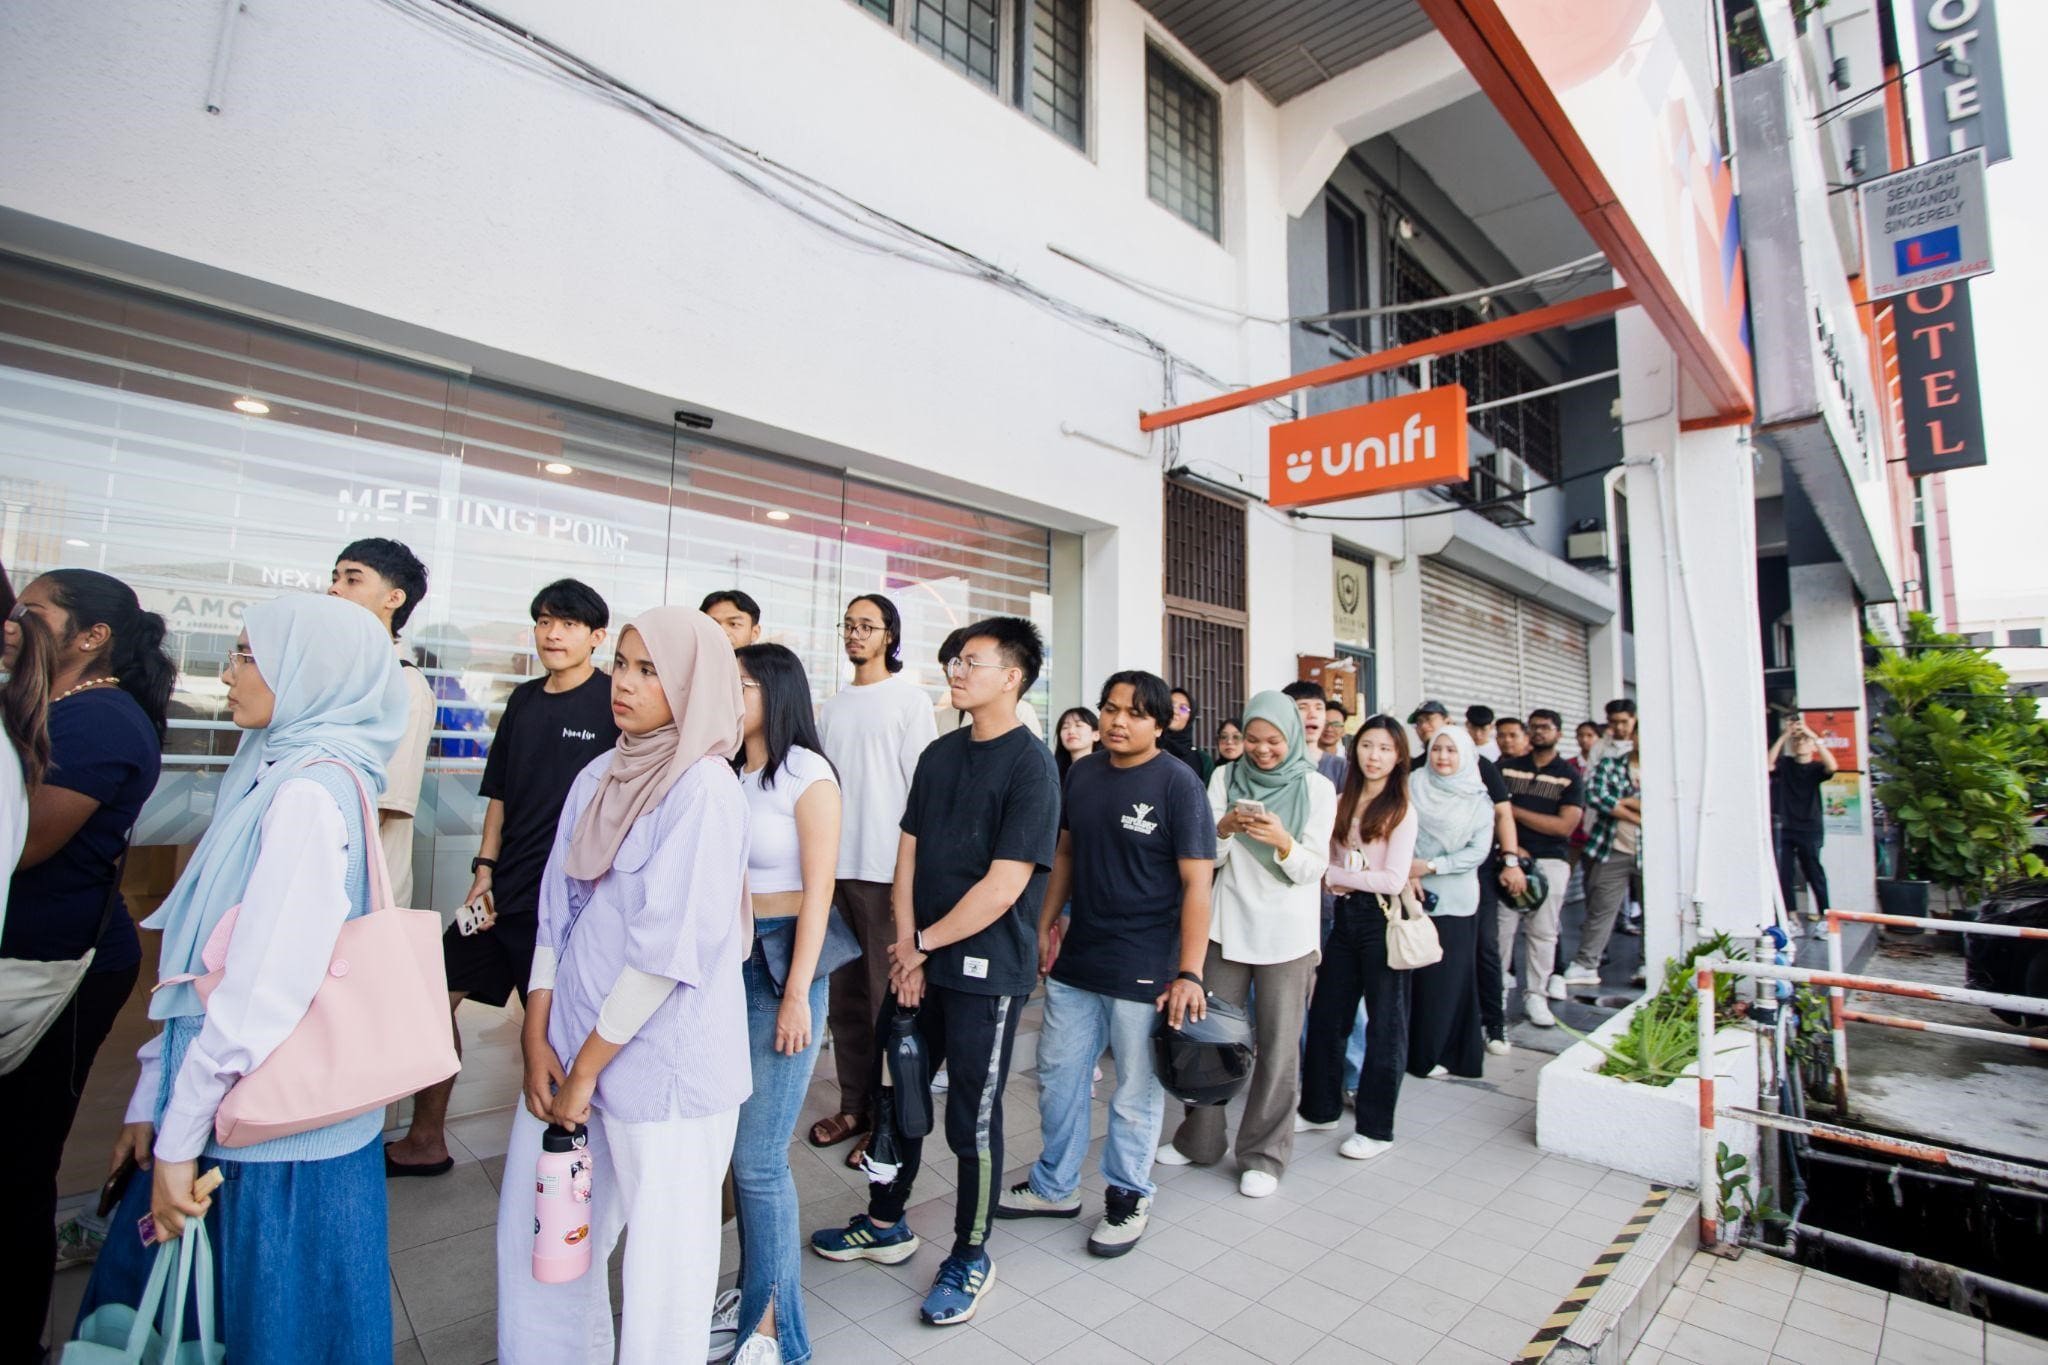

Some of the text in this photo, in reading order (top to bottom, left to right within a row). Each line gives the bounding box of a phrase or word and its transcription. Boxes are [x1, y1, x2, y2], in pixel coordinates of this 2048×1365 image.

[1885, 187, 1961, 217] MEMANDU
[1887, 171, 1956, 202] SEKOLAH
[1884, 200, 1965, 234] SINCERELY
[1907, 240, 1950, 267] L
[1321, 412, 1436, 477] unifi
[337, 488, 629, 561] MEETING POINT
